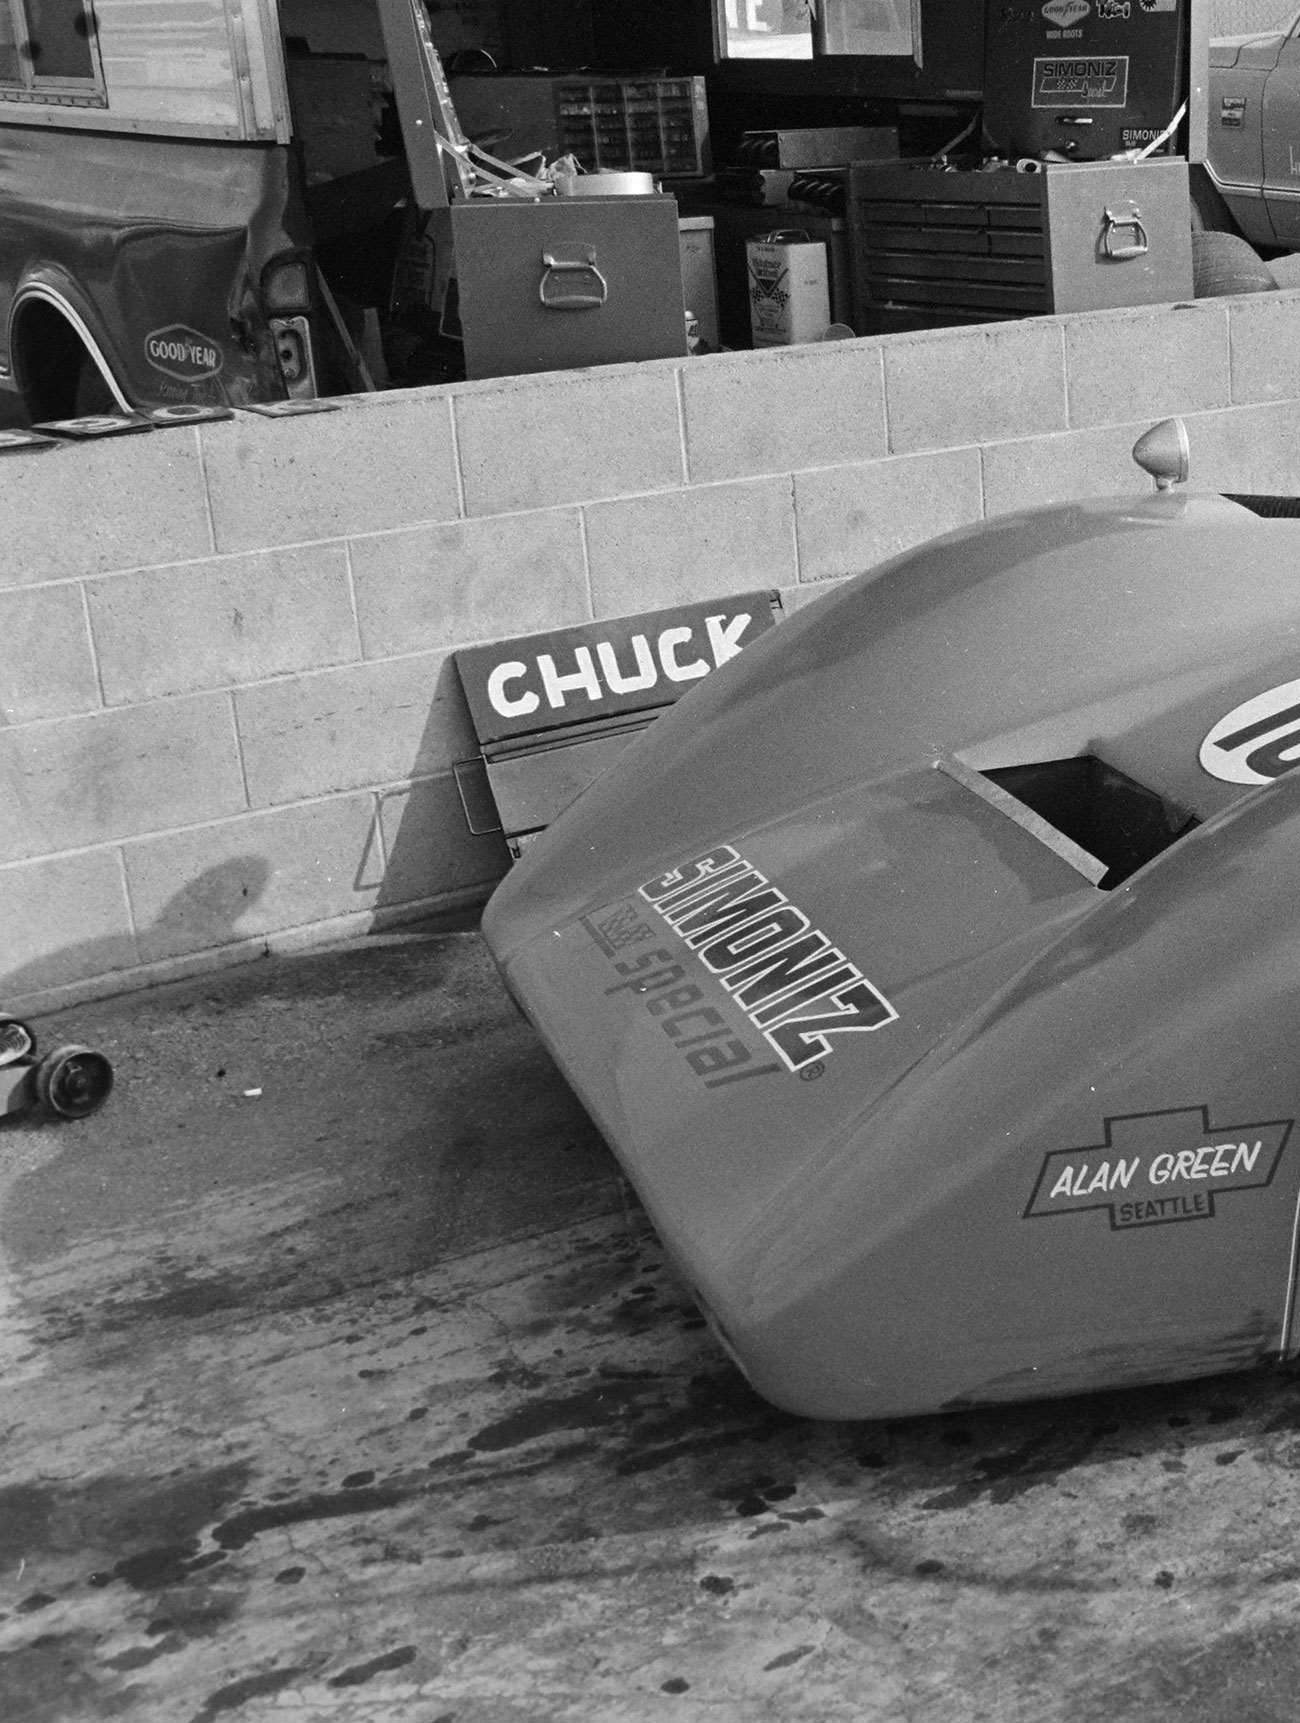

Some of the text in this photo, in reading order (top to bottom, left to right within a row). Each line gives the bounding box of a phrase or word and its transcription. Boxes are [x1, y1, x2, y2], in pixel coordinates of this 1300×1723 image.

[1043, 61, 1118, 77] SIMONIZ
[150, 340, 217, 368] GOODYEAR
[488, 613, 752, 718] CHUCK
[637, 844, 901, 1073] SIMONIZ
[1050, 1140, 1262, 1198] ALAN GREEN
[1119, 1193, 1205, 1222] SEATTLE
